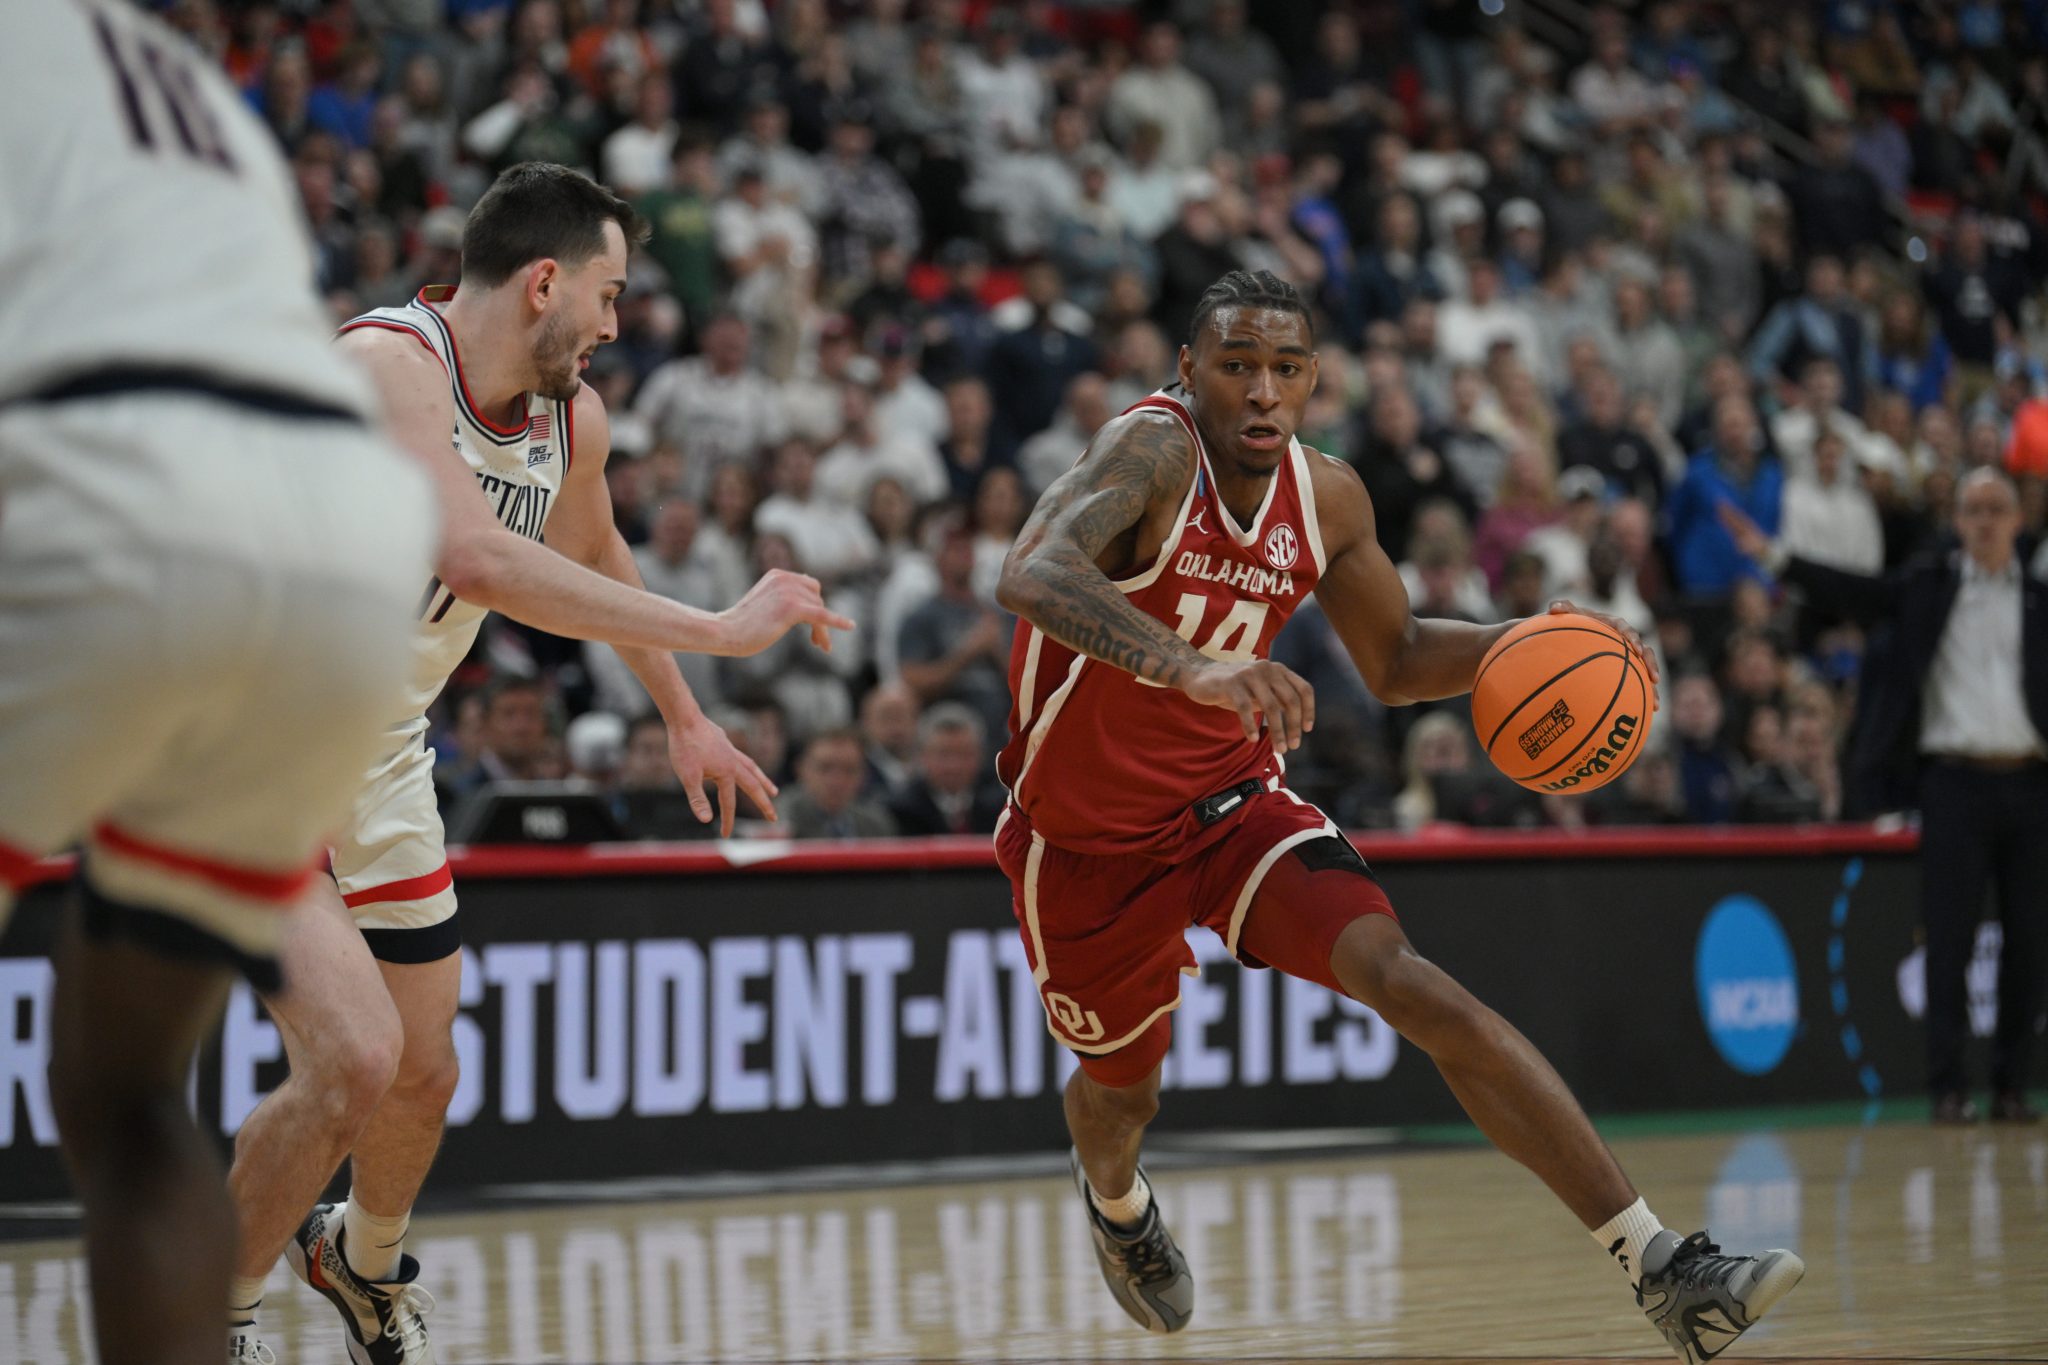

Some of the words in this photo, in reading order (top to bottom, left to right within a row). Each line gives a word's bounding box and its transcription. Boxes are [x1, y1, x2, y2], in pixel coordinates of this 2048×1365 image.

[528, 453, 553, 464] EAST
[529, 445, 548, 455] BIG
[1267, 526, 1296, 567] SEC
[1174, 550, 1295, 596] OKLAHOMA
[1140, 592, 1270, 686] 14
[1518, 717, 1557, 750] MADNESS
[1536, 722, 1567, 749] MARCH
[1541, 714, 1639, 791] Wilson
